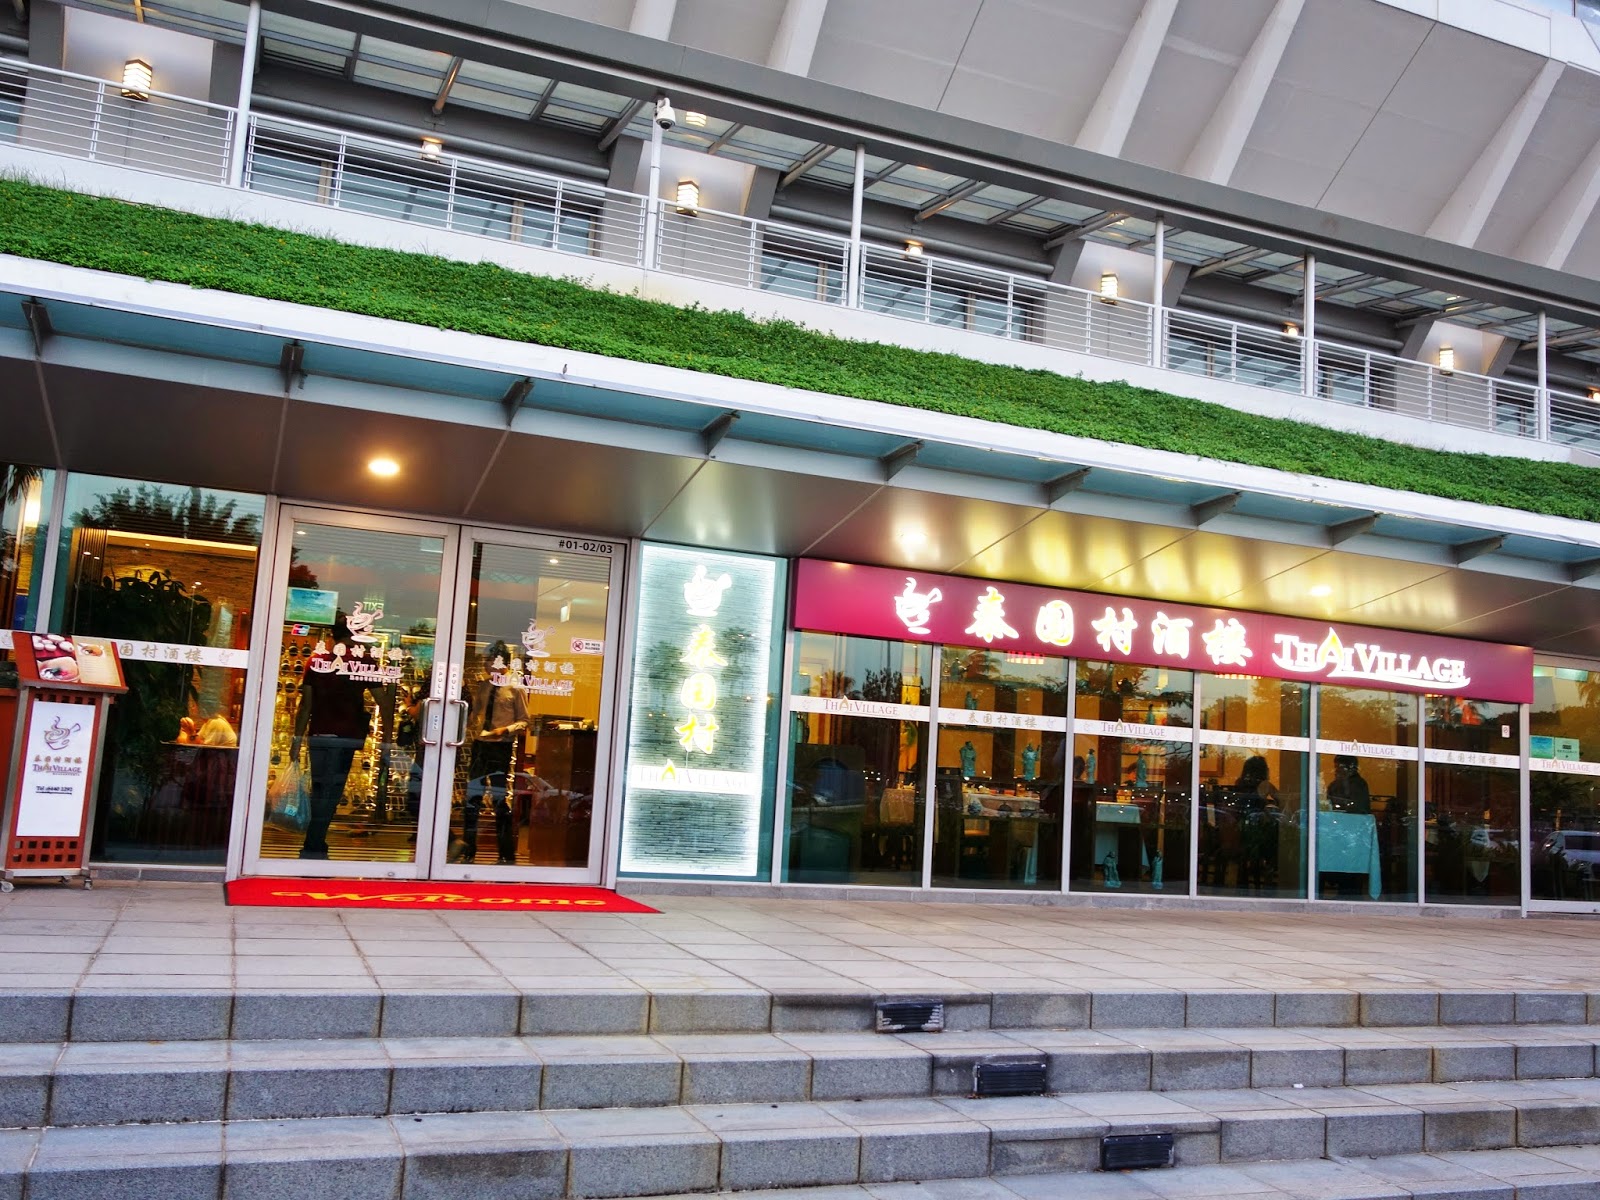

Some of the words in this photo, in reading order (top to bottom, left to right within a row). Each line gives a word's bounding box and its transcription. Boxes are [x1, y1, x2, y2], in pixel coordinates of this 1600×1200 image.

[558, 540, 613, 554] #01-02/03
[120, 642, 203, 663] 国村酒楼
[1353, 643, 1467, 682] VILLAGE
[854, 701, 899, 715] VILLAGE
[1128, 724, 1166, 737] VILLAGE
[271, 891, 607, 906] Welcome
